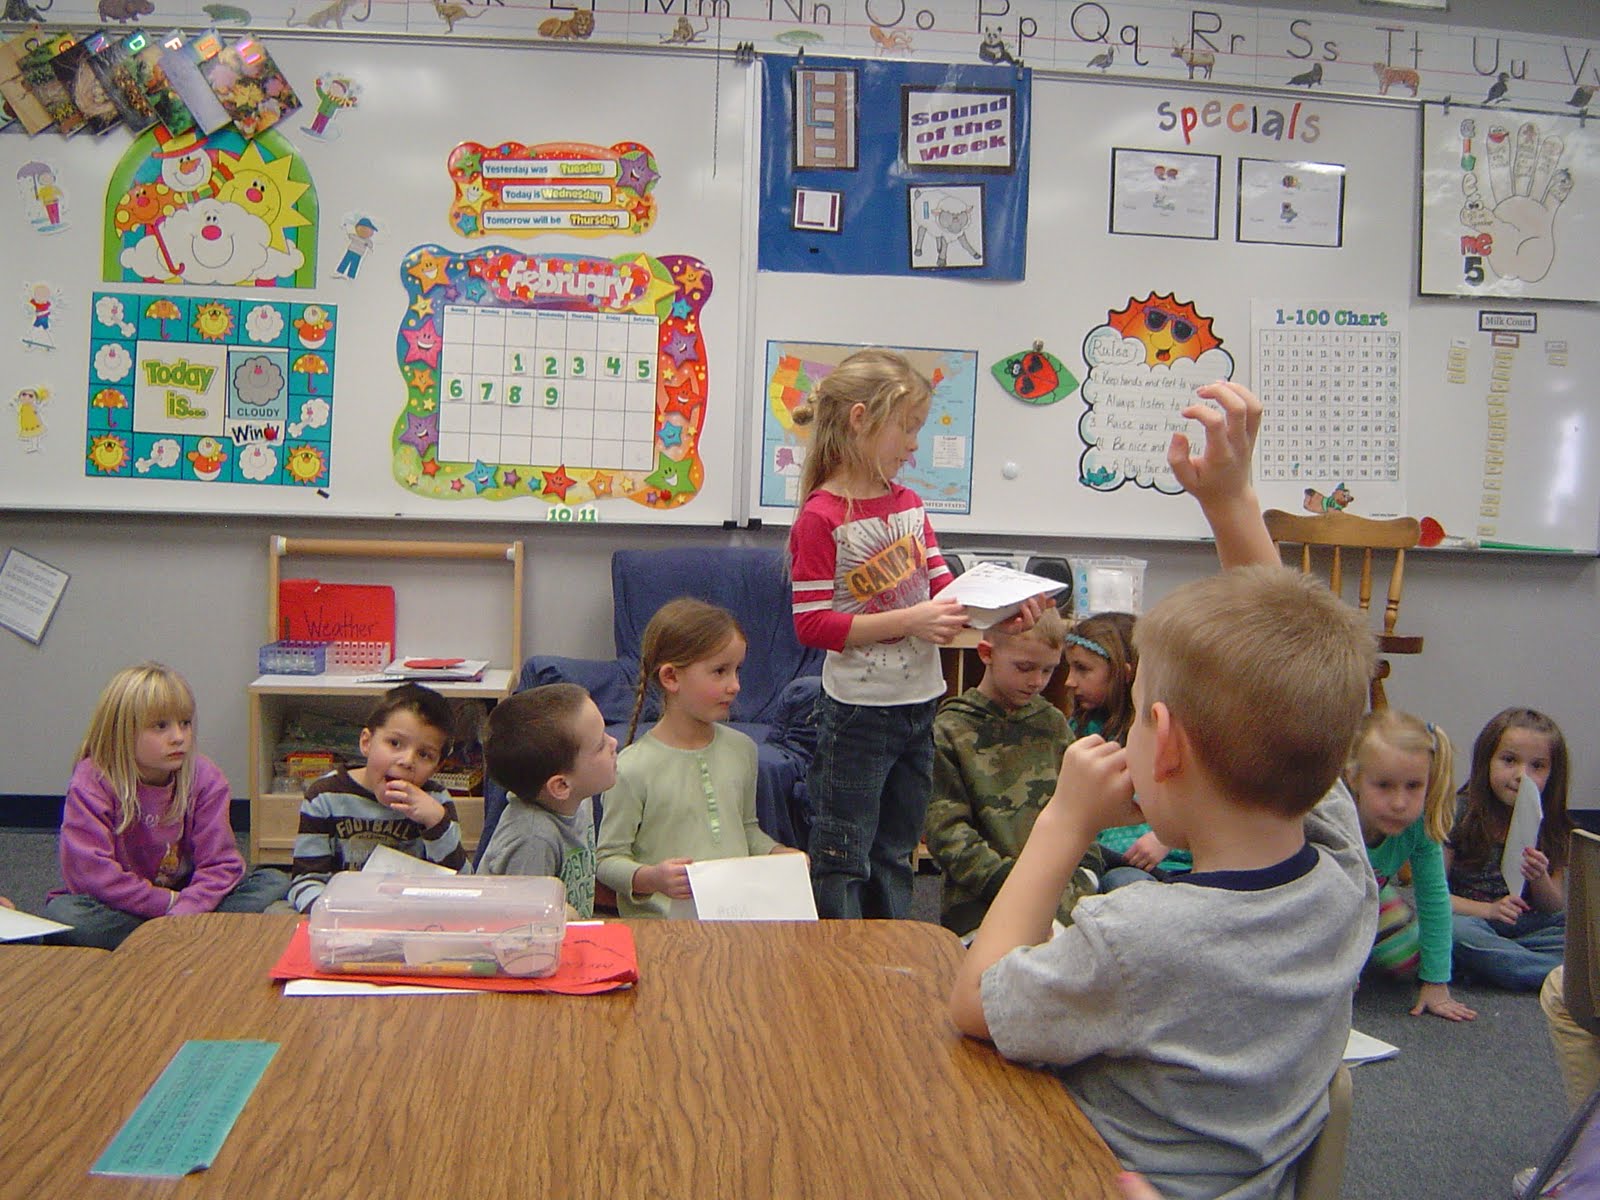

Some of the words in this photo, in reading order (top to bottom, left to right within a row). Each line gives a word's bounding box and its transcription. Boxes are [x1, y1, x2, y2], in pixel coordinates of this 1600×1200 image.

[978, 0, 1038, 57] Pp
[1070, 2, 1149, 66] Qq
[1190, 10, 1246, 54] Rr
[1285, 19, 1338, 62] Ss
[1375, 26, 1423, 70] Tt
[1472, 36, 1526, 80] Uu
[916, 126, 946, 144] of
[954, 118, 1003, 137] the
[485, 165, 528, 175] Yesterday
[531, 166, 548, 174] was
[560, 163, 604, 176] Tuesday
[505, 190, 532, 200] Today
[534, 190, 540, 198] is
[541, 188, 602, 202] Wednesday
[486, 216, 531, 225] Tomorrow
[533, 216, 548, 224] will
[550, 216, 562, 224] be
[570, 214, 619, 228] Thursday
[1464, 256, 1485, 286] 5
[1276, 309, 1330, 326] 1-100
[1334, 311, 1388, 326] Chart
[1485, 316, 1504, 326] Milk
[1506, 318, 1532, 326] Count
[1092, 340, 1129, 358] Rules
[514, 354, 524, 372] 1
[545, 358, 558, 376] 2
[572, 357, 584, 375] 3
[607, 356, 621, 375] 4
[638, 360, 650, 378] 5
[144, 361, 214, 391] Today
[450, 380, 463, 398] 6
[481, 383, 493, 400] 7
[509, 386, 522, 404] 8
[545, 388, 558, 406] 9
[1106, 394, 1135, 412] Always
[1141, 396, 1165, 409] listen
[237, 408, 280, 418] CLOUDY
[1106, 416, 1133, 430] Raise
[1164, 420, 1188, 432] hand
[232, 423, 280, 444] Winy
[1112, 438, 1125, 451] Be
[1128, 443, 1148, 452] nice
[1150, 444, 1165, 452] and
[550, 509, 572, 522] 10
[580, 509, 596, 522] 11
[851, 545, 910, 594] CAMP
[304, 605, 374, 638] Weather
[336, 818, 410, 840] FOOTBALL
